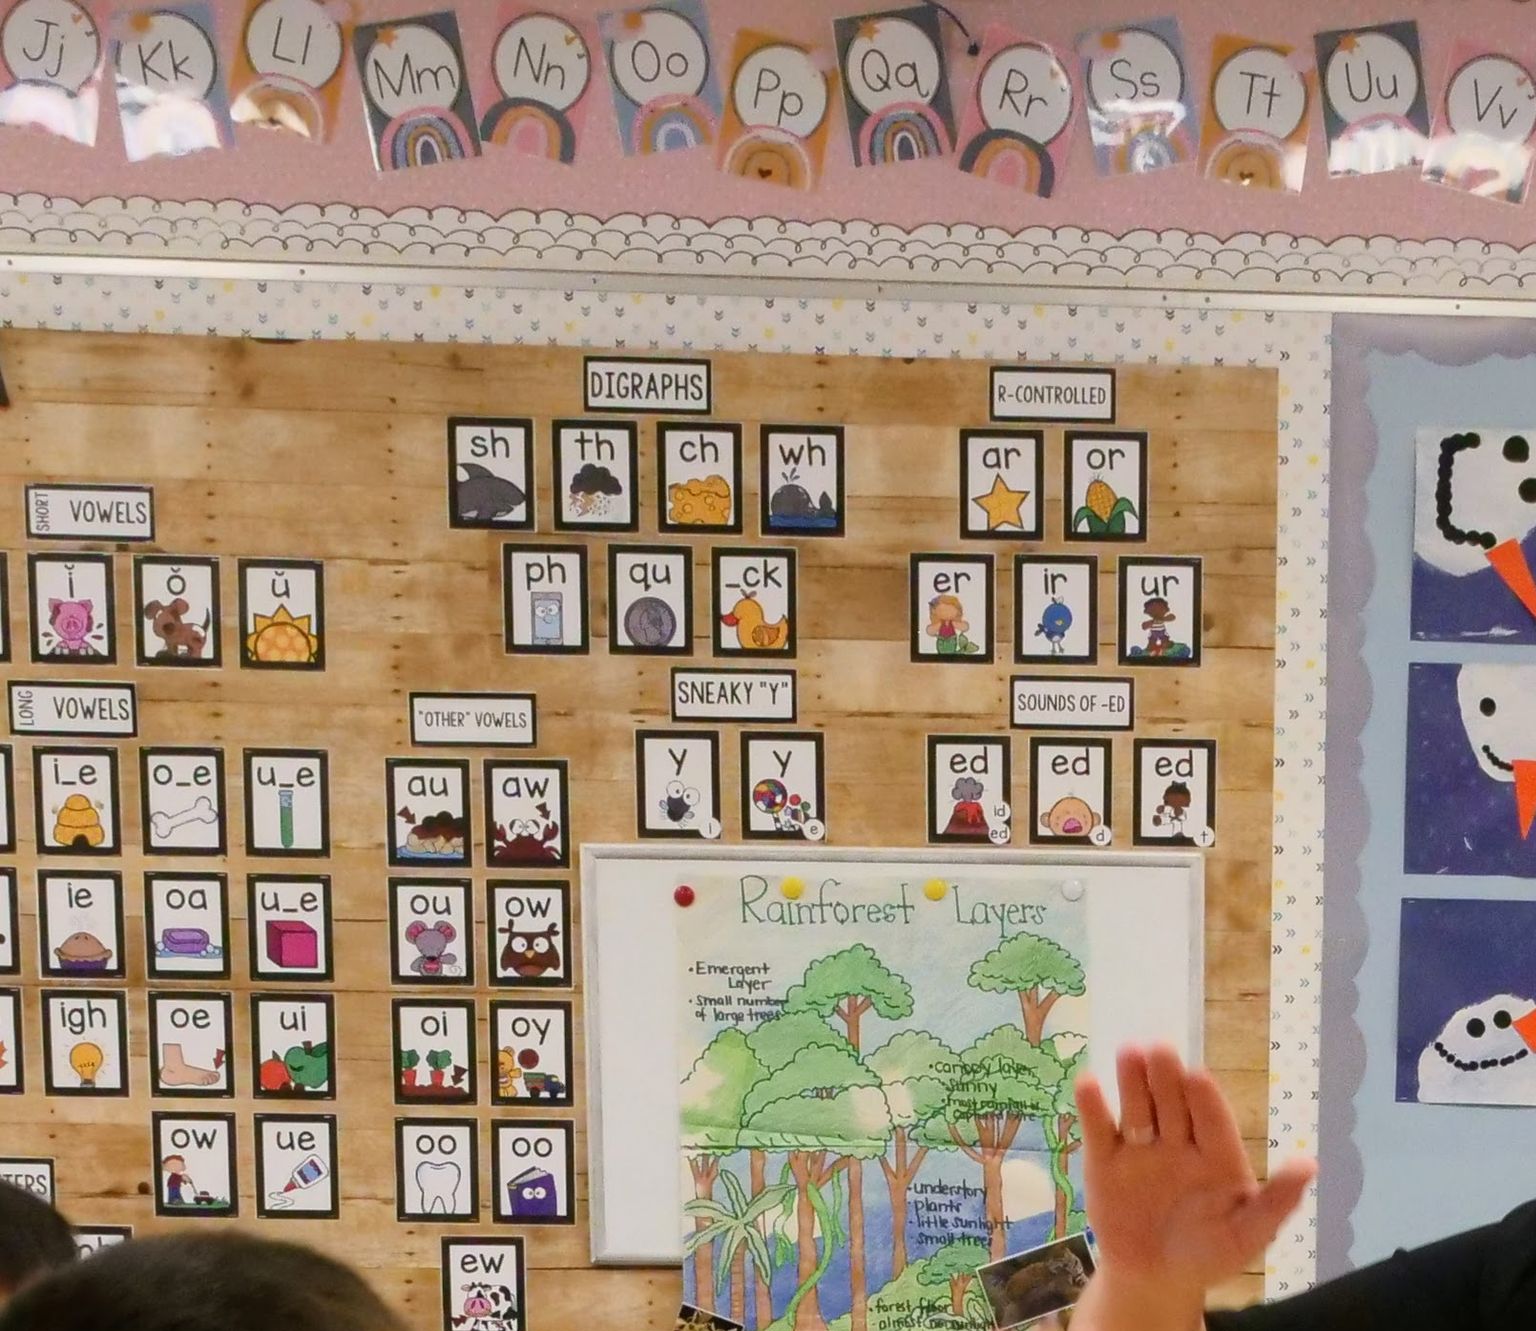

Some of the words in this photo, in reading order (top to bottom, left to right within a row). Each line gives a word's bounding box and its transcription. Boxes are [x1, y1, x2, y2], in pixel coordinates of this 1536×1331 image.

[22, 19, 65, 78] Jj
[272, 17, 309, 65] Ll
[138, 42, 193, 83] Kk
[512, 37, 566, 91] Nn
[631, 41, 687, 83] Oo
[861, 49, 930, 99] Qq
[373, 56, 457, 100] Mm
[1109, 59, 1161, 100] Ss
[1344, 62, 1399, 103] Uu
[754, 68, 803, 127] Pp
[999, 75, 1049, 118] Rr
[1240, 71, 1278, 118] Tt
[1473, 79, 1518, 130] Vv
[591, 371, 703, 401] DIGRAPHS
[998, 384, 1106, 406] R-CONTROLLED
[470, 429, 510, 459] sh
[575, 432, 615, 461] th
[679, 435, 719, 463] ch
[779, 438, 826, 466] wh
[983, 447, 1021, 469] ar
[1087, 448, 1125, 470] or
[35, 491, 50, 531] SHORT
[69, 500, 147, 524] VOWELS
[525, 555, 566, 590] ph
[629, 561, 671, 592] qu
[933, 570, 971, 594] er
[1044, 568, 1067, 594] ir
[1141, 573, 1179, 597] ur
[678, 681, 752, 704] SNEAKY
[760, 682, 788, 704] "Y"
[1018, 693, 1076, 712] SOUNDS
[1080, 694, 1096, 712] OF
[1101, 695, 1125, 712] -ED
[18, 690, 33, 726] LONG
[52, 697, 130, 721] VOWELS
[418, 711, 471, 728] "OTHER"
[475, 712, 527, 729] VOWELS
[669, 748, 687, 775] y
[772, 749, 792, 778] y
[950, 746, 988, 774] ed
[1051, 748, 1090, 776] ed
[1155, 750, 1194, 777] ed
[408, 774, 448, 797] au
[502, 776, 549, 798] aw
[812, 825, 819, 835] e
[991, 827, 1008, 839] ed
[1096, 830, 1105, 842] d
[1200, 831, 1208, 843] t
[67, 882, 94, 909] ie
[165, 887, 207, 910] oa
[410, 894, 451, 916] ou
[505, 896, 551, 918] ow
[740, 875, 915, 925] Rainforest
[953, 885, 1047, 938] Layers
[696, 961, 770, 980] Emergent
[728, 977, 772, 994] Layer
[60, 1000, 107, 1035] igh
[170, 1007, 210, 1029] oe
[280, 1005, 307, 1032] ui
[421, 1011, 448, 1037] oi
[695, 1007, 707, 1021] of
[713, 1008, 744, 1026] large
[747, 1008, 780, 1021] trees
[512, 1017, 551, 1045] oy
[171, 1128, 217, 1150] ow
[277, 1129, 315, 1151] ue
[416, 1134, 457, 1155] oo
[512, 1137, 552, 1157] oo
[914, 1179, 987, 1204] understory
[915, 1197, 961, 1217] plants
[917, 1214, 949, 1228] little
[956, 1233, 993, 1247] trees
[460, 1253, 505, 1274] ew
[875, 1297, 912, 1313] forest
[879, 1317, 924, 1330] almost
